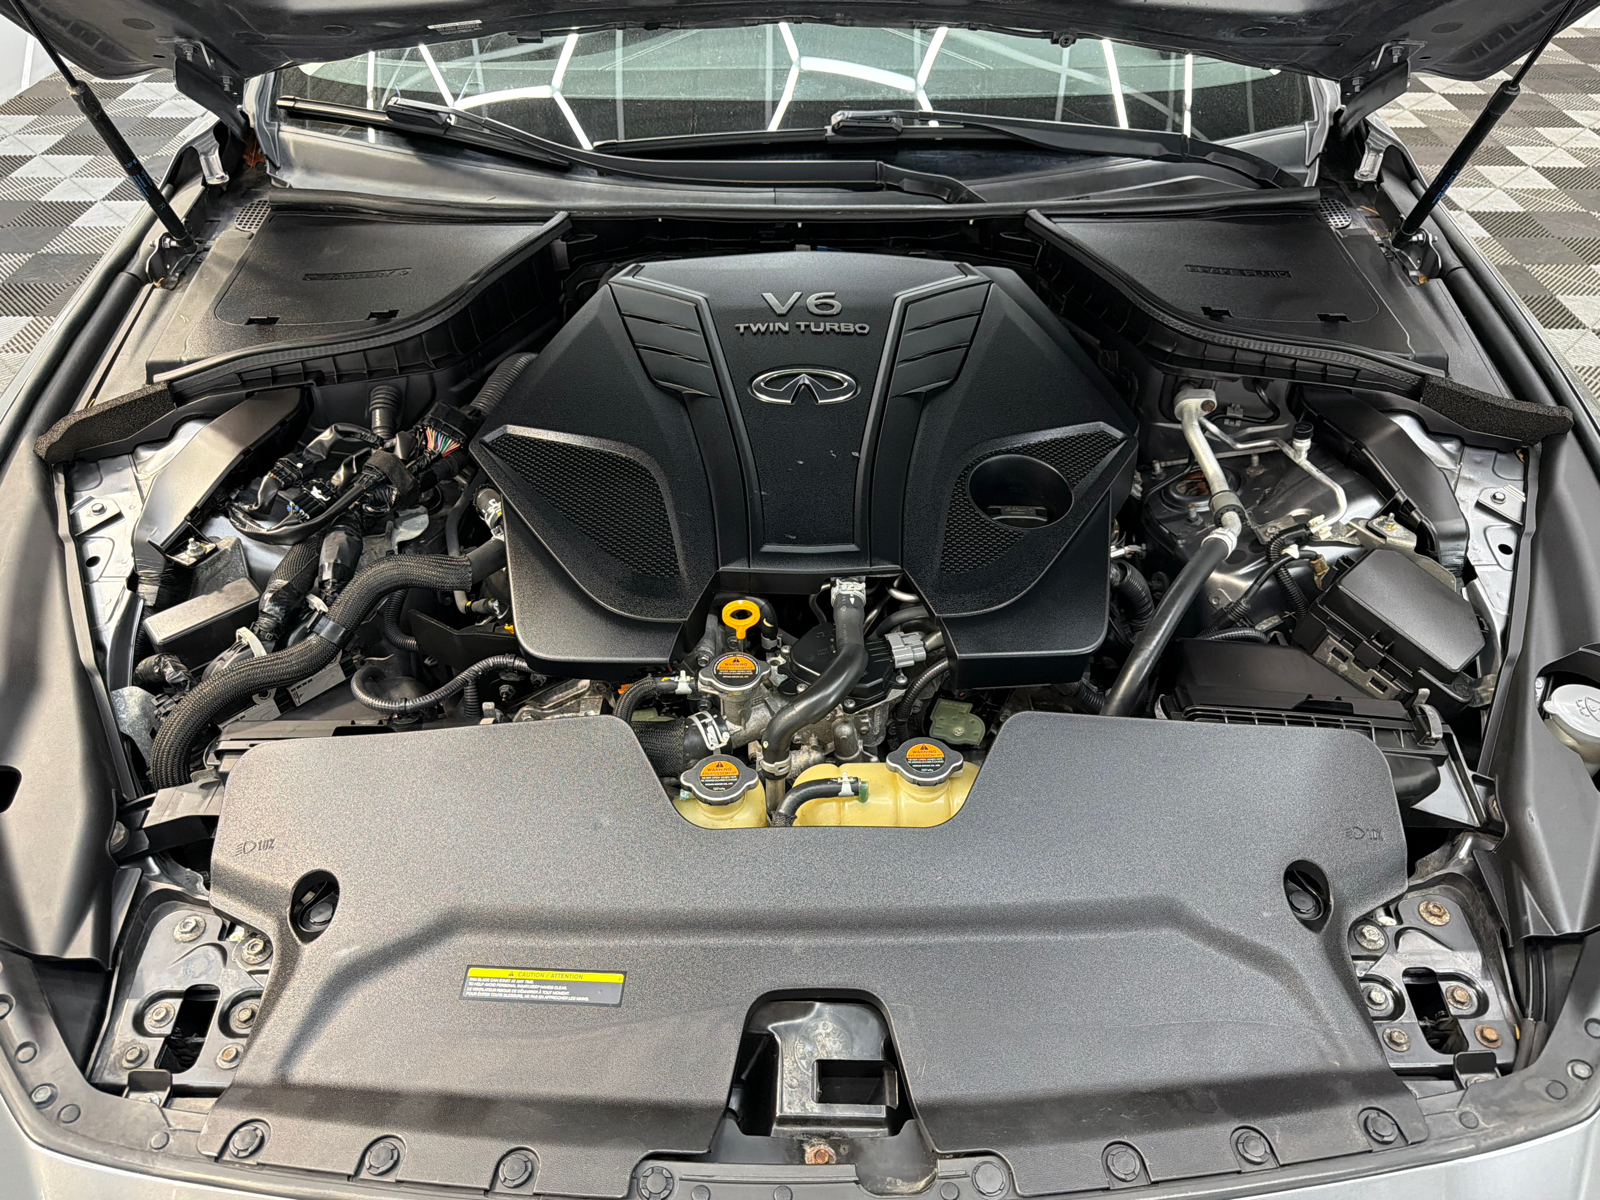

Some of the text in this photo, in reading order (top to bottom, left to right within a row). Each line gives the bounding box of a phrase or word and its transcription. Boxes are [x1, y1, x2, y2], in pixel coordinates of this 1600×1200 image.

[761, 291, 842, 316] V6
[735, 321, 871, 334] TWIN TURBO
